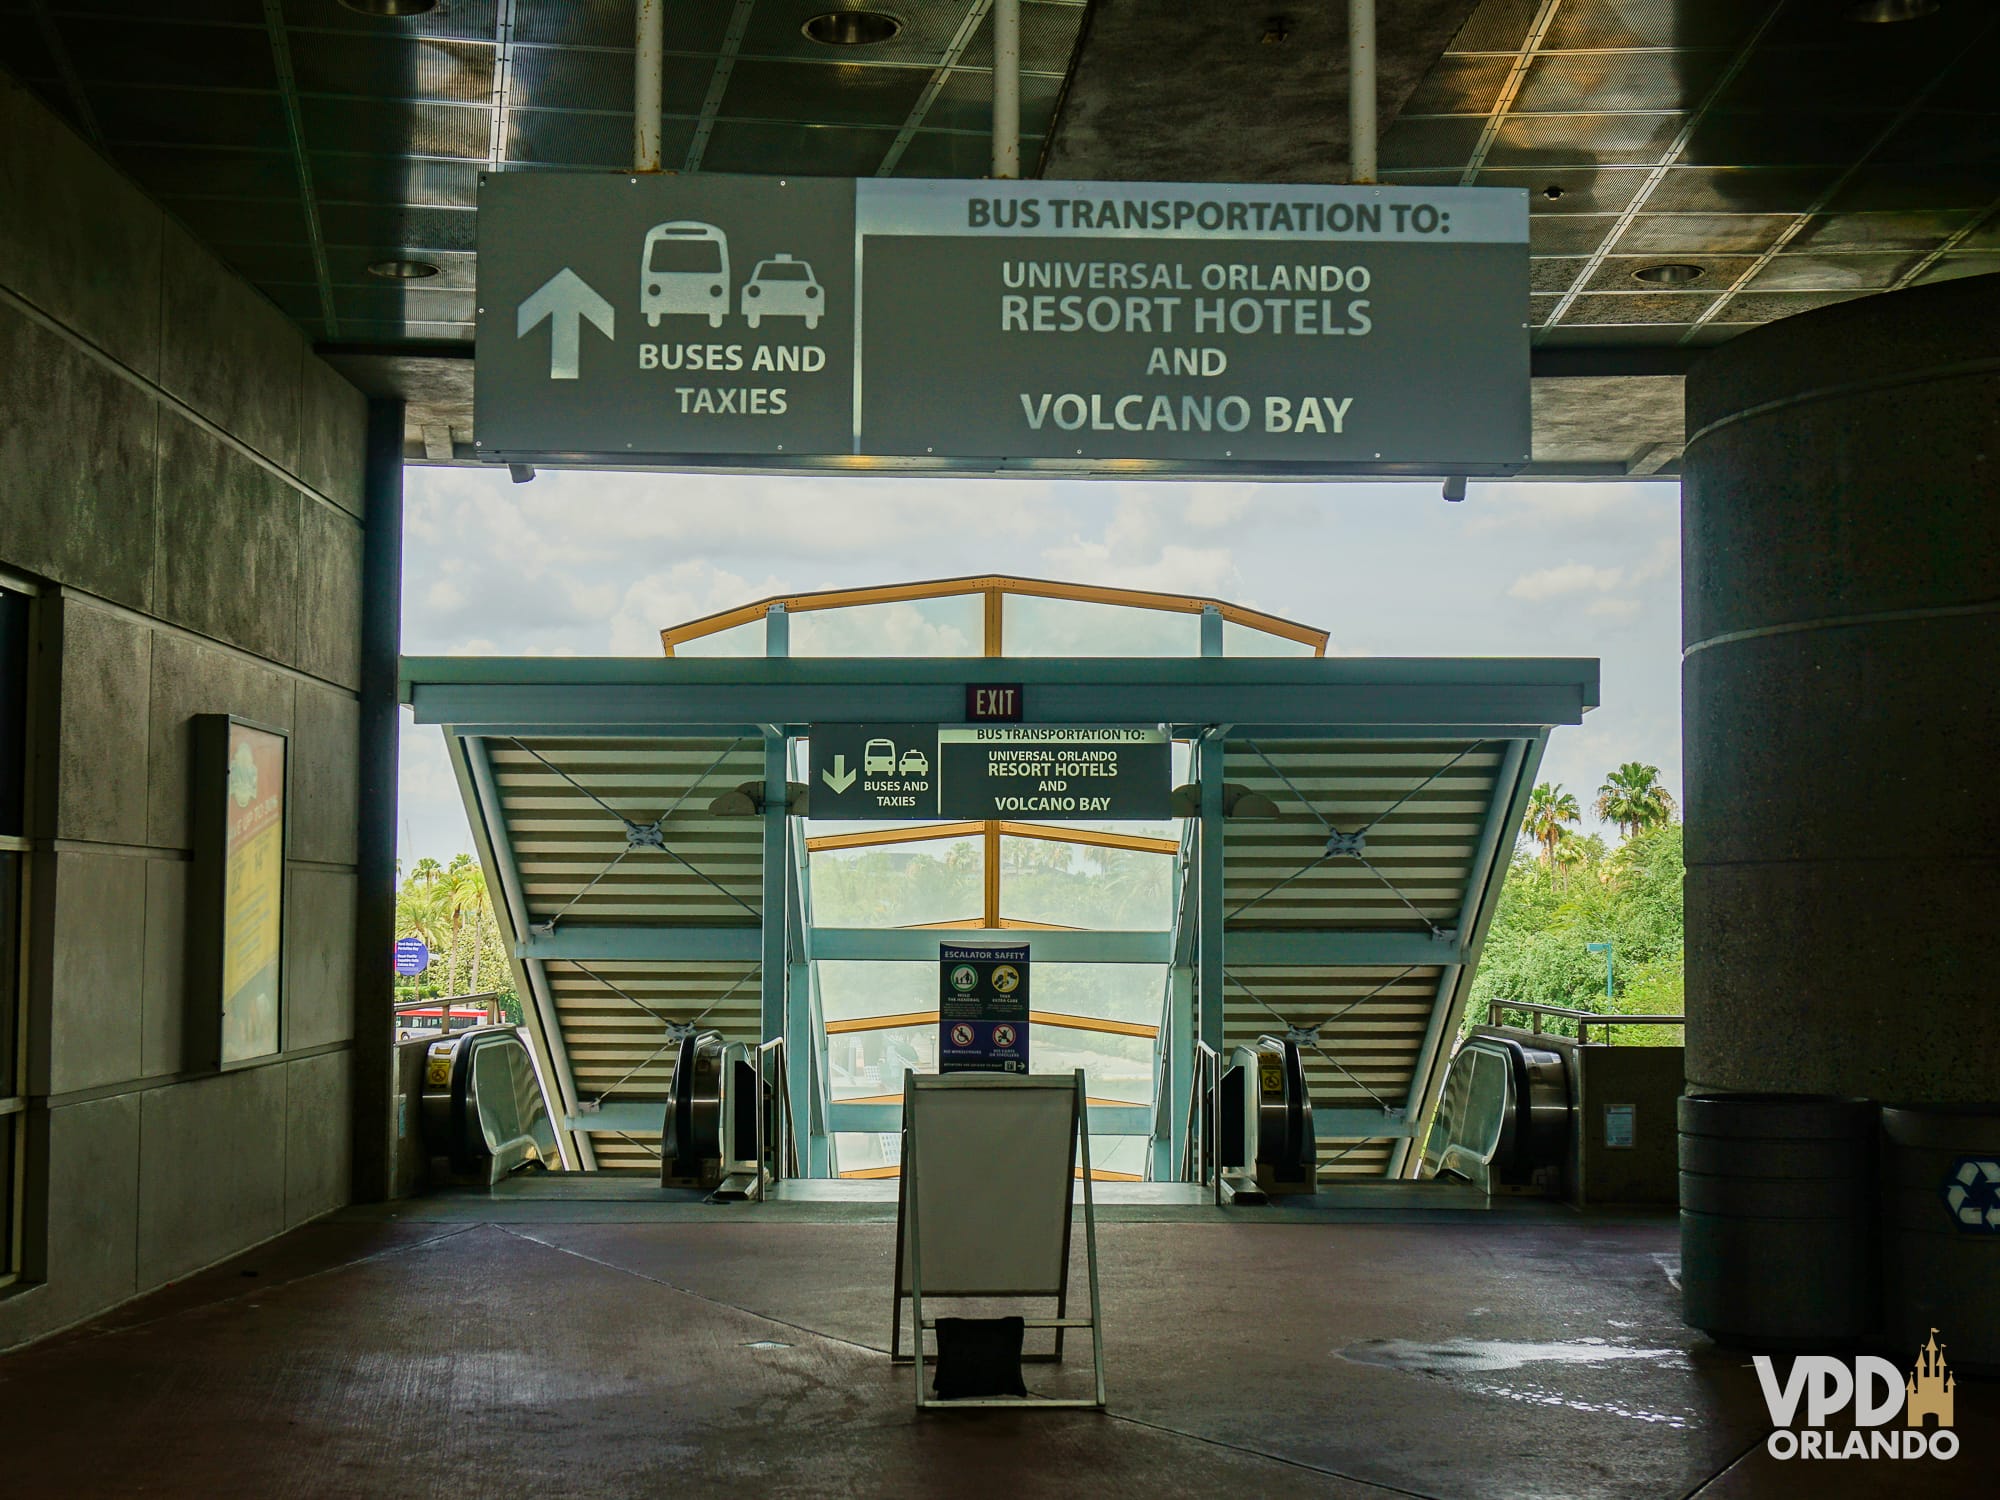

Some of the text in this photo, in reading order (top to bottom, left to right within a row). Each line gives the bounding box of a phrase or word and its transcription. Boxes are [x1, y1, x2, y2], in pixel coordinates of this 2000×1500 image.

[968, 198, 1452, 234] BUS TRANSPORTATION TO:
[1003, 261, 1371, 293] UNIVERSAL ORLANDO
[1001, 295, 1372, 336] RESORT HOTELS
[639, 343, 826, 372] BUSES AND
[1147, 347, 1227, 377] AND
[675, 388, 788, 415] TAXIES
[1020, 393, 1354, 434] VOLCANO BAY
[976, 689, 1015, 715] EXIT
[976, 729, 1145, 741] BUS TRANSPORTATION TO:
[988, 750, 1118, 762] UNIVERSAL ORLANDO
[988, 762, 1118, 777] RESORT HOTELS
[864, 781, 929, 792] BUSES AND
[1038, 780, 1067, 792] AND
[876, 796, 916, 807] TAXIES
[994, 796, 1111, 811] VOLCANO BAY
[944, 950, 1025, 960] ESCALATOR SAFETY
